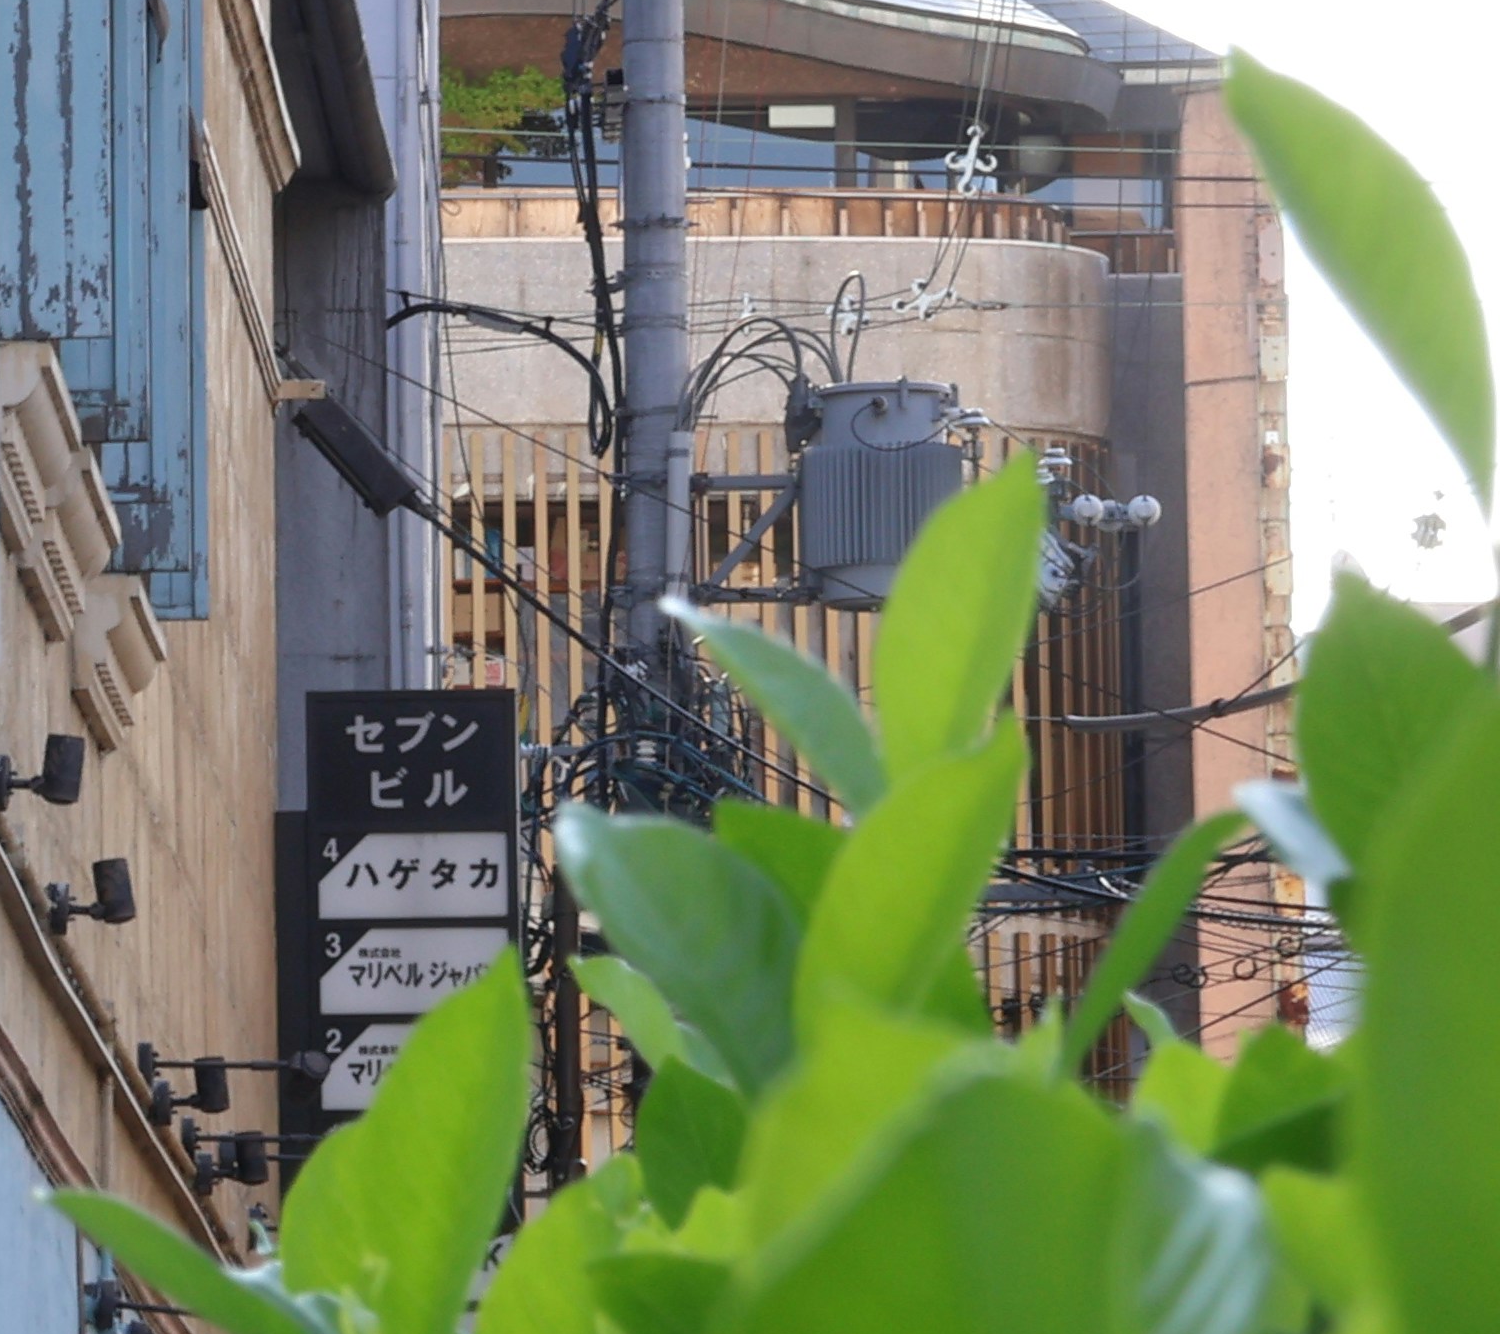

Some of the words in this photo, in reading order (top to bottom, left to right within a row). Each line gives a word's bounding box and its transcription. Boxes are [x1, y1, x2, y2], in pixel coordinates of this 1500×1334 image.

[345, 712, 479, 754] セブン
[369, 767, 469, 809] ビル
[322, 838, 340, 863] 4
[345, 857, 500, 891] ハゲタカ
[325, 932, 342, 958] 3
[325, 1028, 343, 1054] 2
[348, 1059, 393, 1086] マリ
